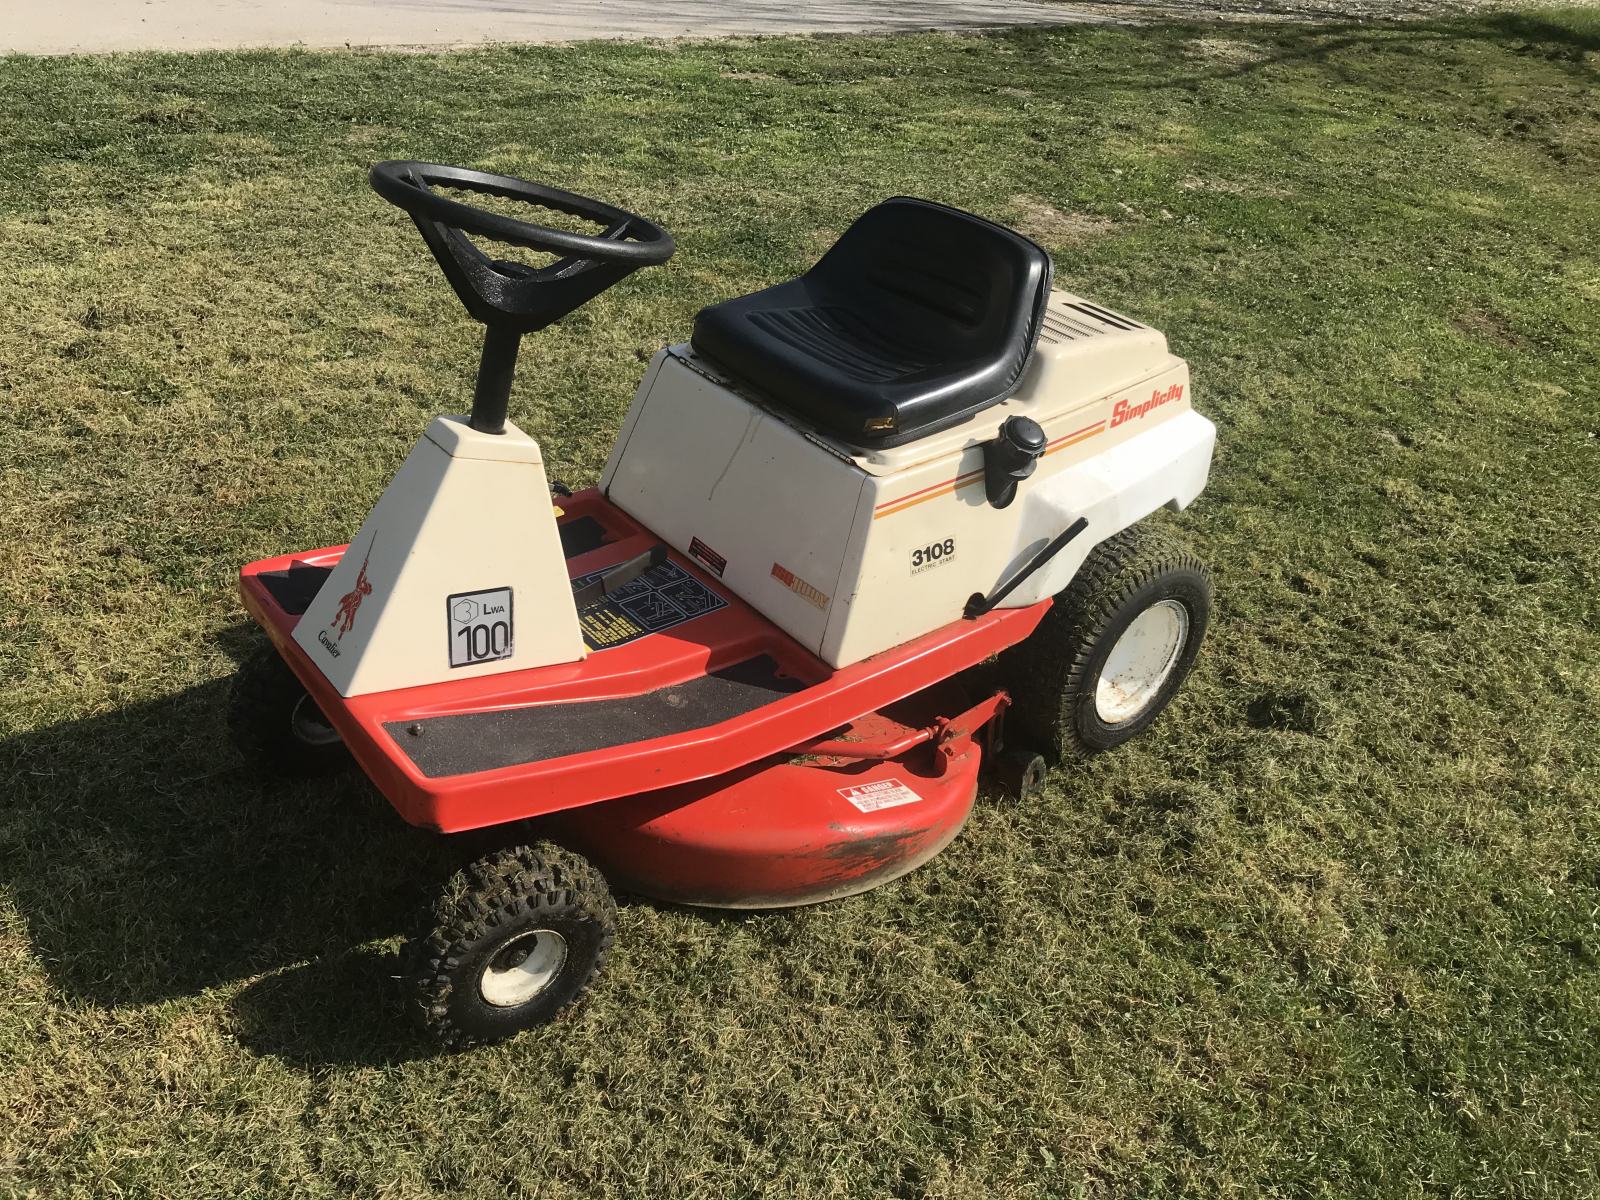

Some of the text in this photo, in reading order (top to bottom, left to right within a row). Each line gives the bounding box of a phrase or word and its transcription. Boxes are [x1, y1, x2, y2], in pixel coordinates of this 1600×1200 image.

[1110, 384, 1184, 428] Simplicity
[912, 538, 955, 567] 3108
[318, 630, 341, 659] Cavalier
[457, 620, 509, 661] 100
